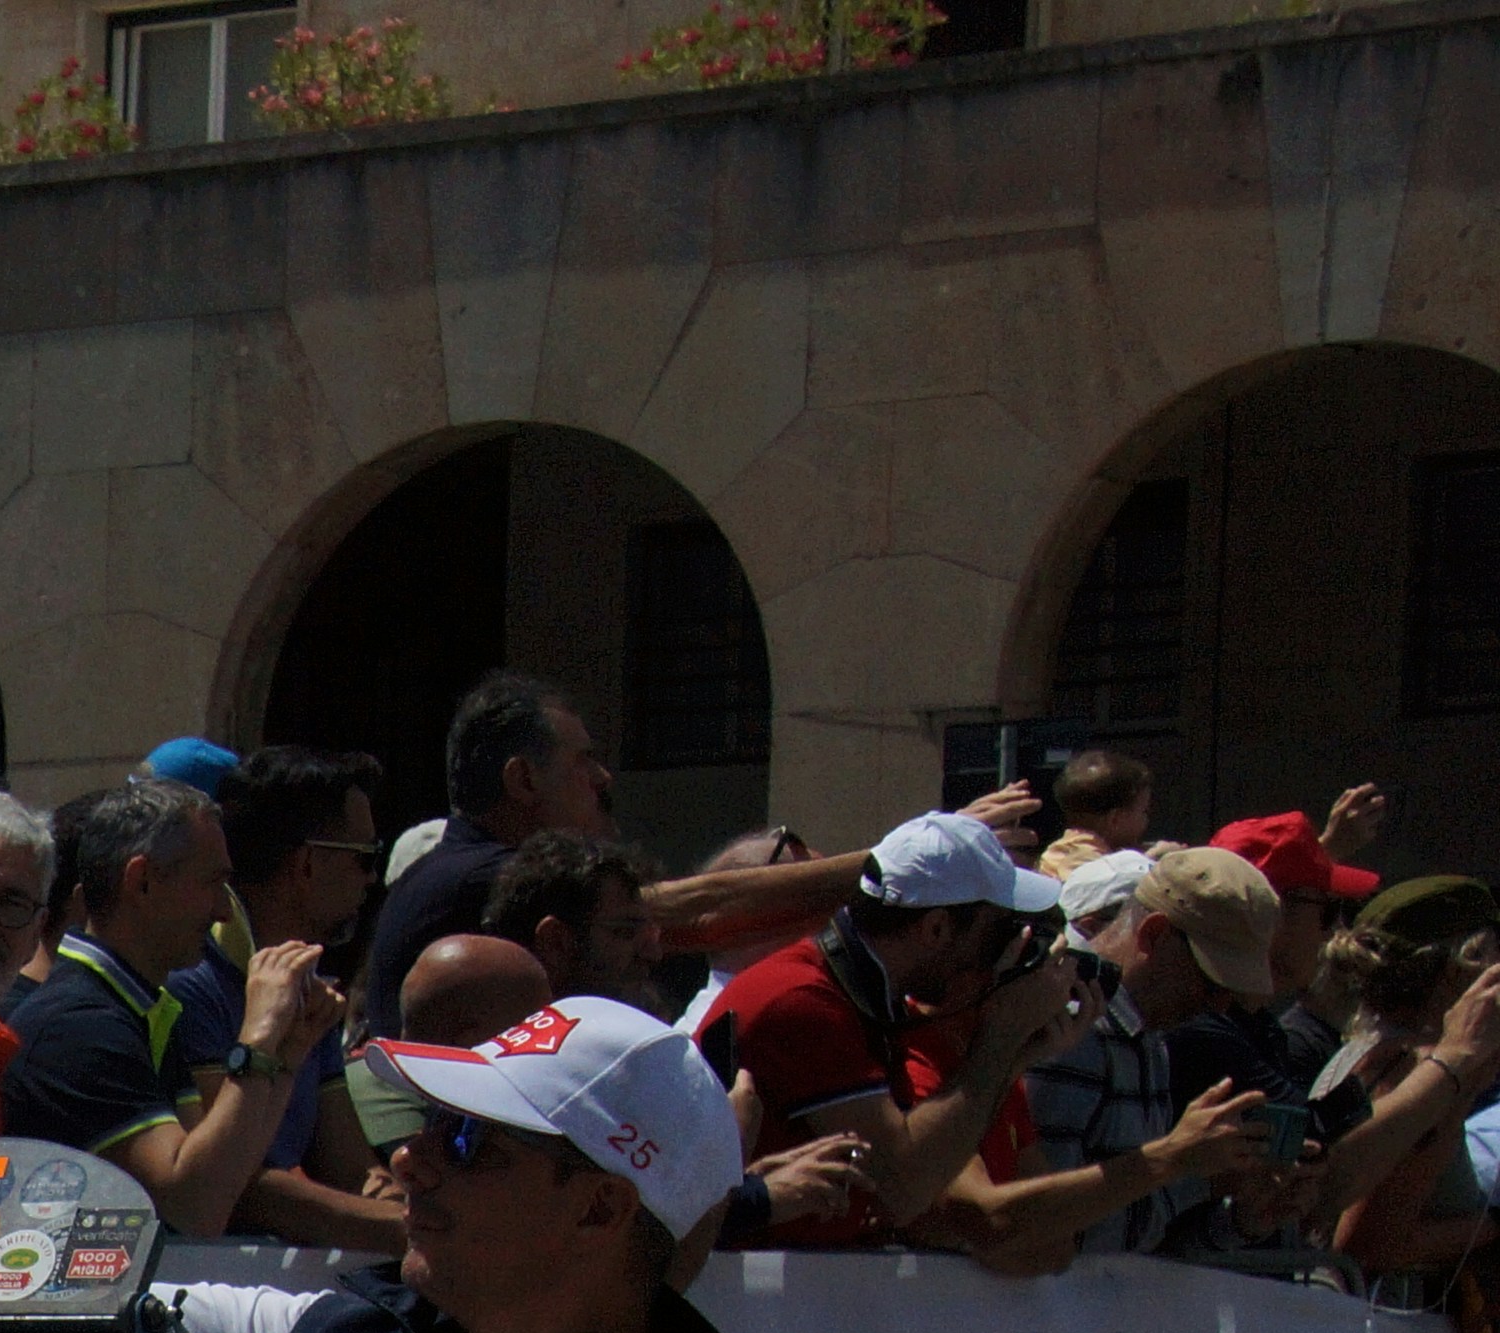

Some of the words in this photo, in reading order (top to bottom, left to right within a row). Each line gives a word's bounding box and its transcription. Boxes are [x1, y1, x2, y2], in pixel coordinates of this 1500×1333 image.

[606, 1123, 661, 1171] 25
[78, 1252, 118, 1264] 1000
[70, 1264, 117, 1276] MIGLIA
